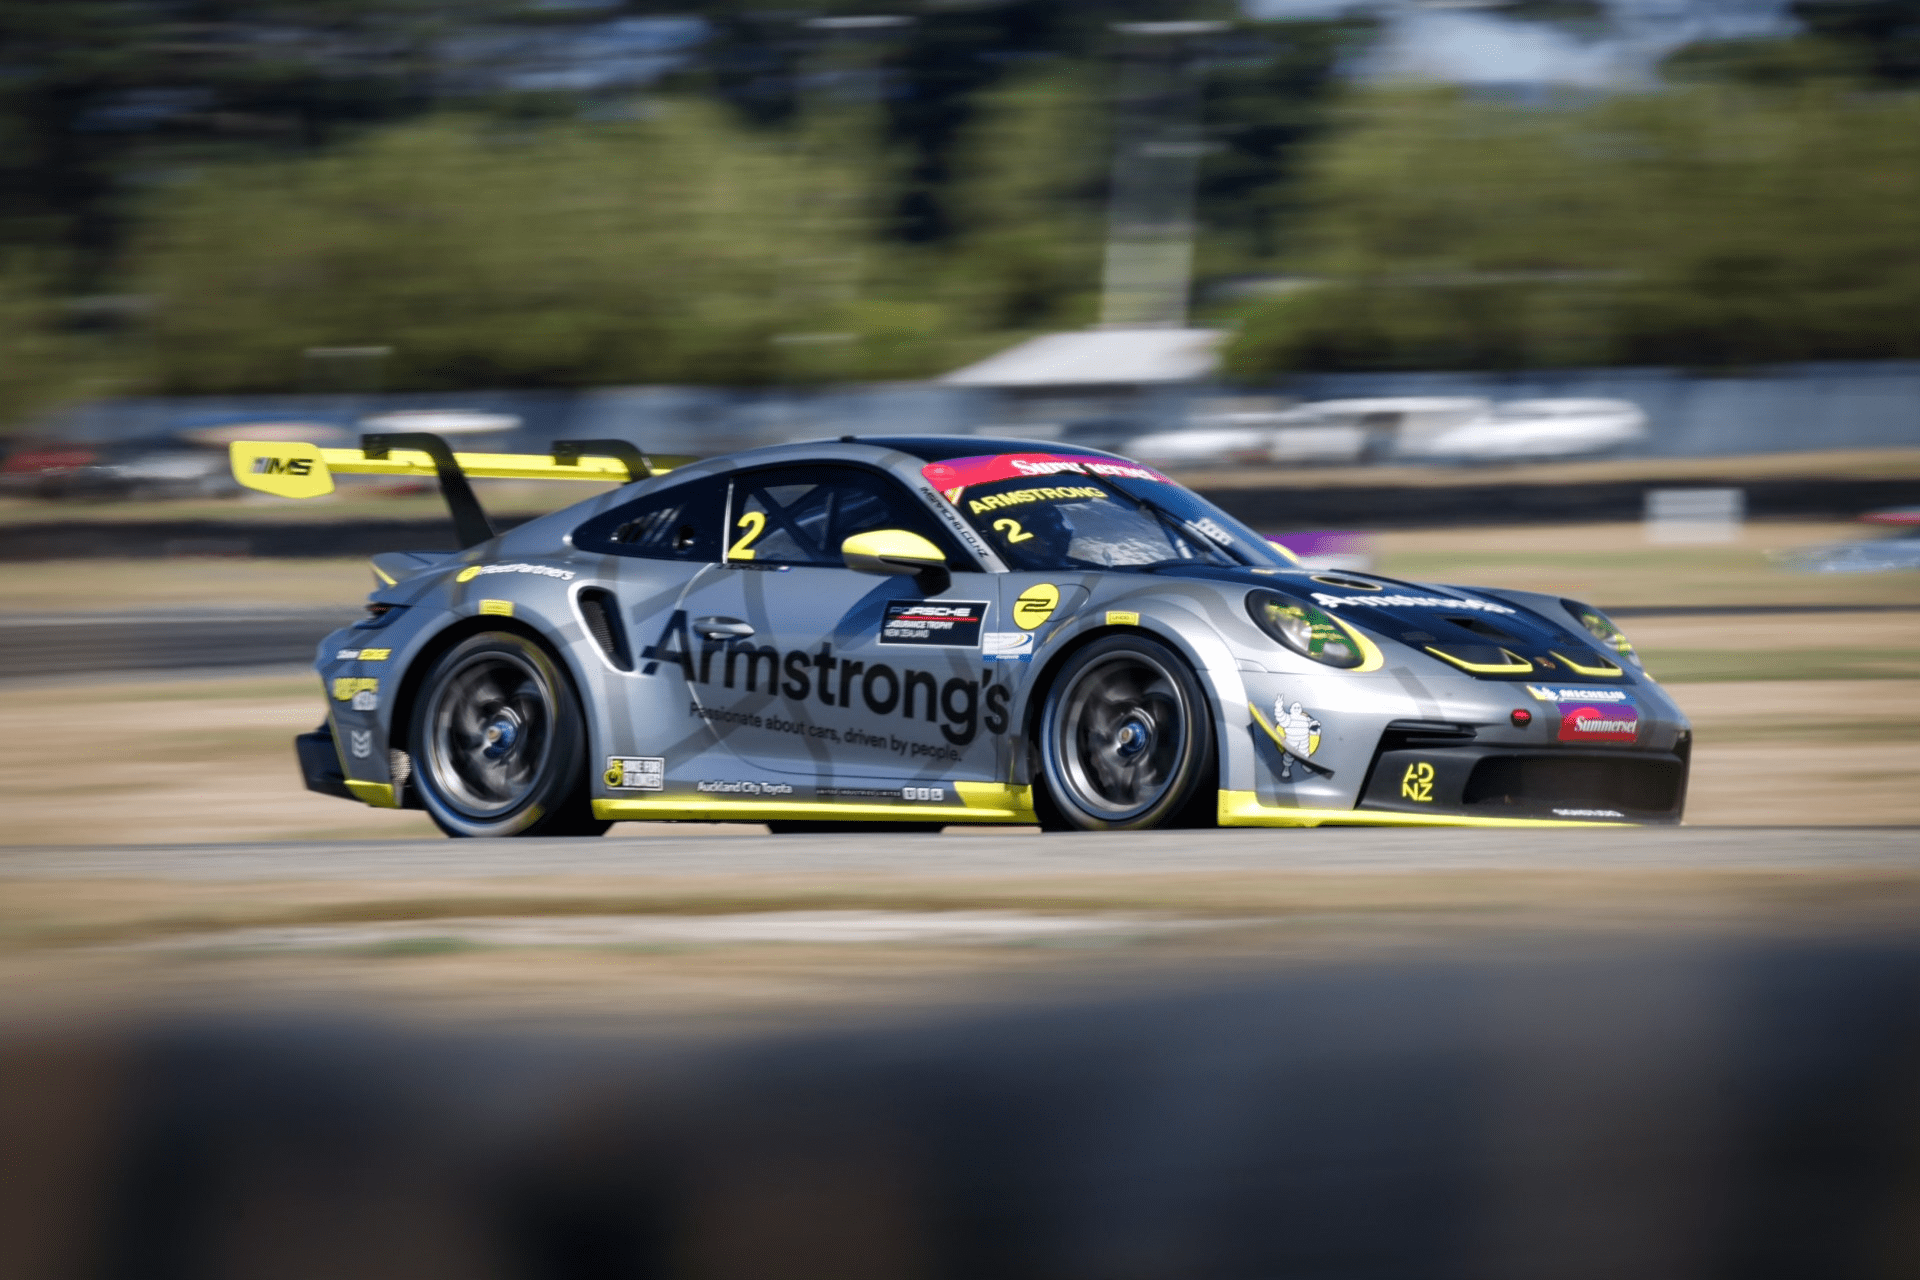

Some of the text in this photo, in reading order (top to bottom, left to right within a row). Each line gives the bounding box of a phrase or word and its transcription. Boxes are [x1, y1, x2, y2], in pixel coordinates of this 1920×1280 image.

[968, 487, 1108, 514] ARMSTRONG
[727, 511, 765, 559] 2
[993, 518, 1034, 543] 2
[889, 606, 972, 617] PORSCHE
[641, 609, 1011, 746] Armstrong's
[1559, 689, 1627, 699] MICHELIN
[689, 701, 962, 762] Passionate about cars, driven by people.
[1574, 715, 1638, 734] Summerset
[697, 780, 793, 796] Auckland City Toyota
[1402, 783, 1434, 801] NZ
